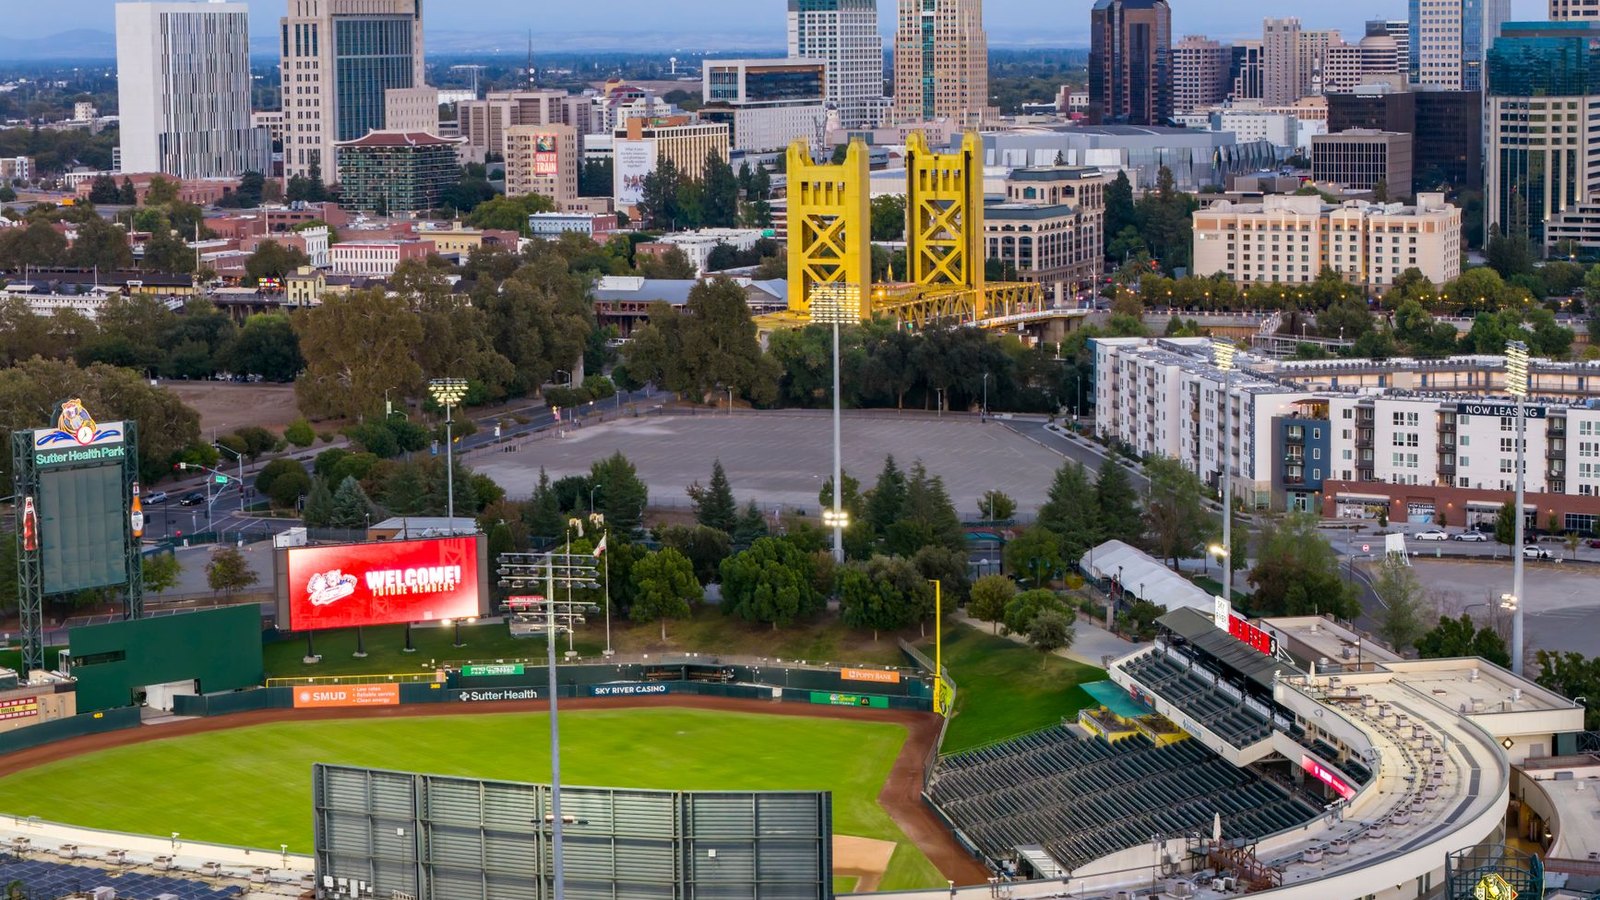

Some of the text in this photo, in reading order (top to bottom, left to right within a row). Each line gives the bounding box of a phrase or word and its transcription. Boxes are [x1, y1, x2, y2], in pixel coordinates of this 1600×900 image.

[536, 153, 556, 161] ONLY BY
[537, 162, 556, 172] TRAIN
[1466, 405, 1538, 417] NOW LEASNG
[36, 446, 125, 465] Sutter Health Park
[365, 565, 461, 590] WELCOME!
[373, 585, 407, 596] FUTURE
[636, 685, 665, 693] CASINO
[313, 692, 347, 701] SMUD
[471, 690, 537, 701] Sutter Health
